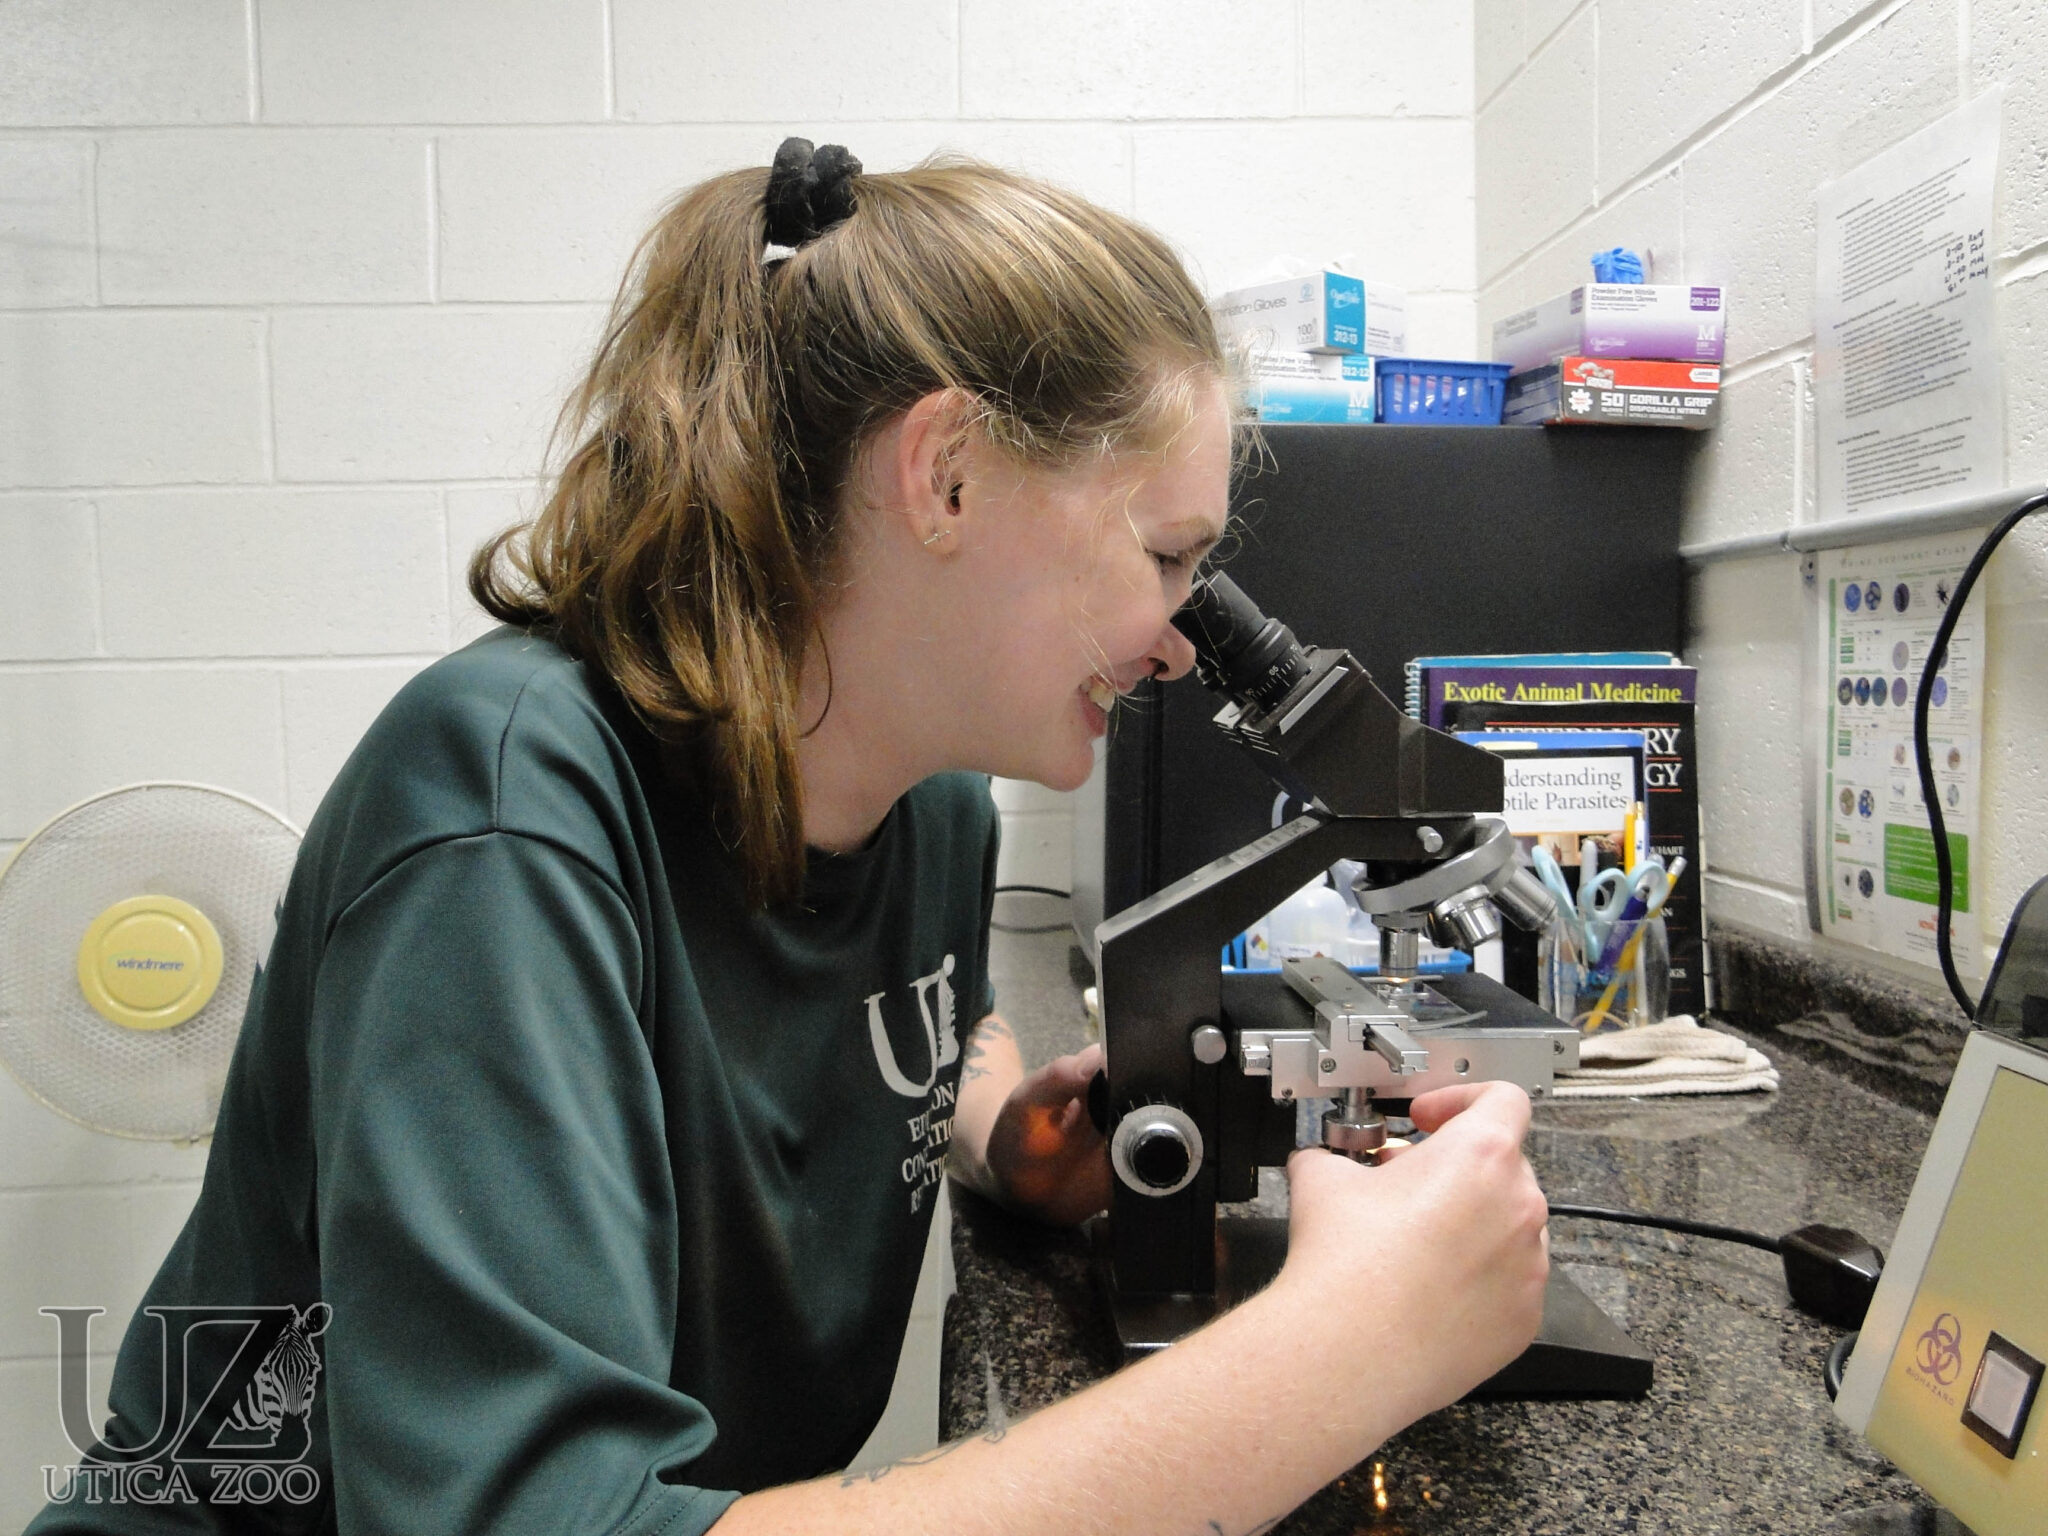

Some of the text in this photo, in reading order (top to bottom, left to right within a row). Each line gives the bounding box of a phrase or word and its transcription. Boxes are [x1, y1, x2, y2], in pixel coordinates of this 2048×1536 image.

[1254, 298, 1287, 312] Gloves
[1697, 325, 1717, 341] M
[1348, 391, 1369, 408] M
[1601, 392, 1624, 407] 50
[1629, 394, 1680, 406] GORILLA
[1683, 397, 1713, 407] GRIP
[1629, 405, 1675, 414] DISPOSABLE
[1677, 407, 1707, 415] NITRILE
[1443, 682, 1506, 702] Exotic
[1513, 682, 1583, 701] Animal
[1590, 683, 1681, 702] Medicine
[1546, 793, 1627, 810] Parasites
[116, 958, 184, 971] windmere
